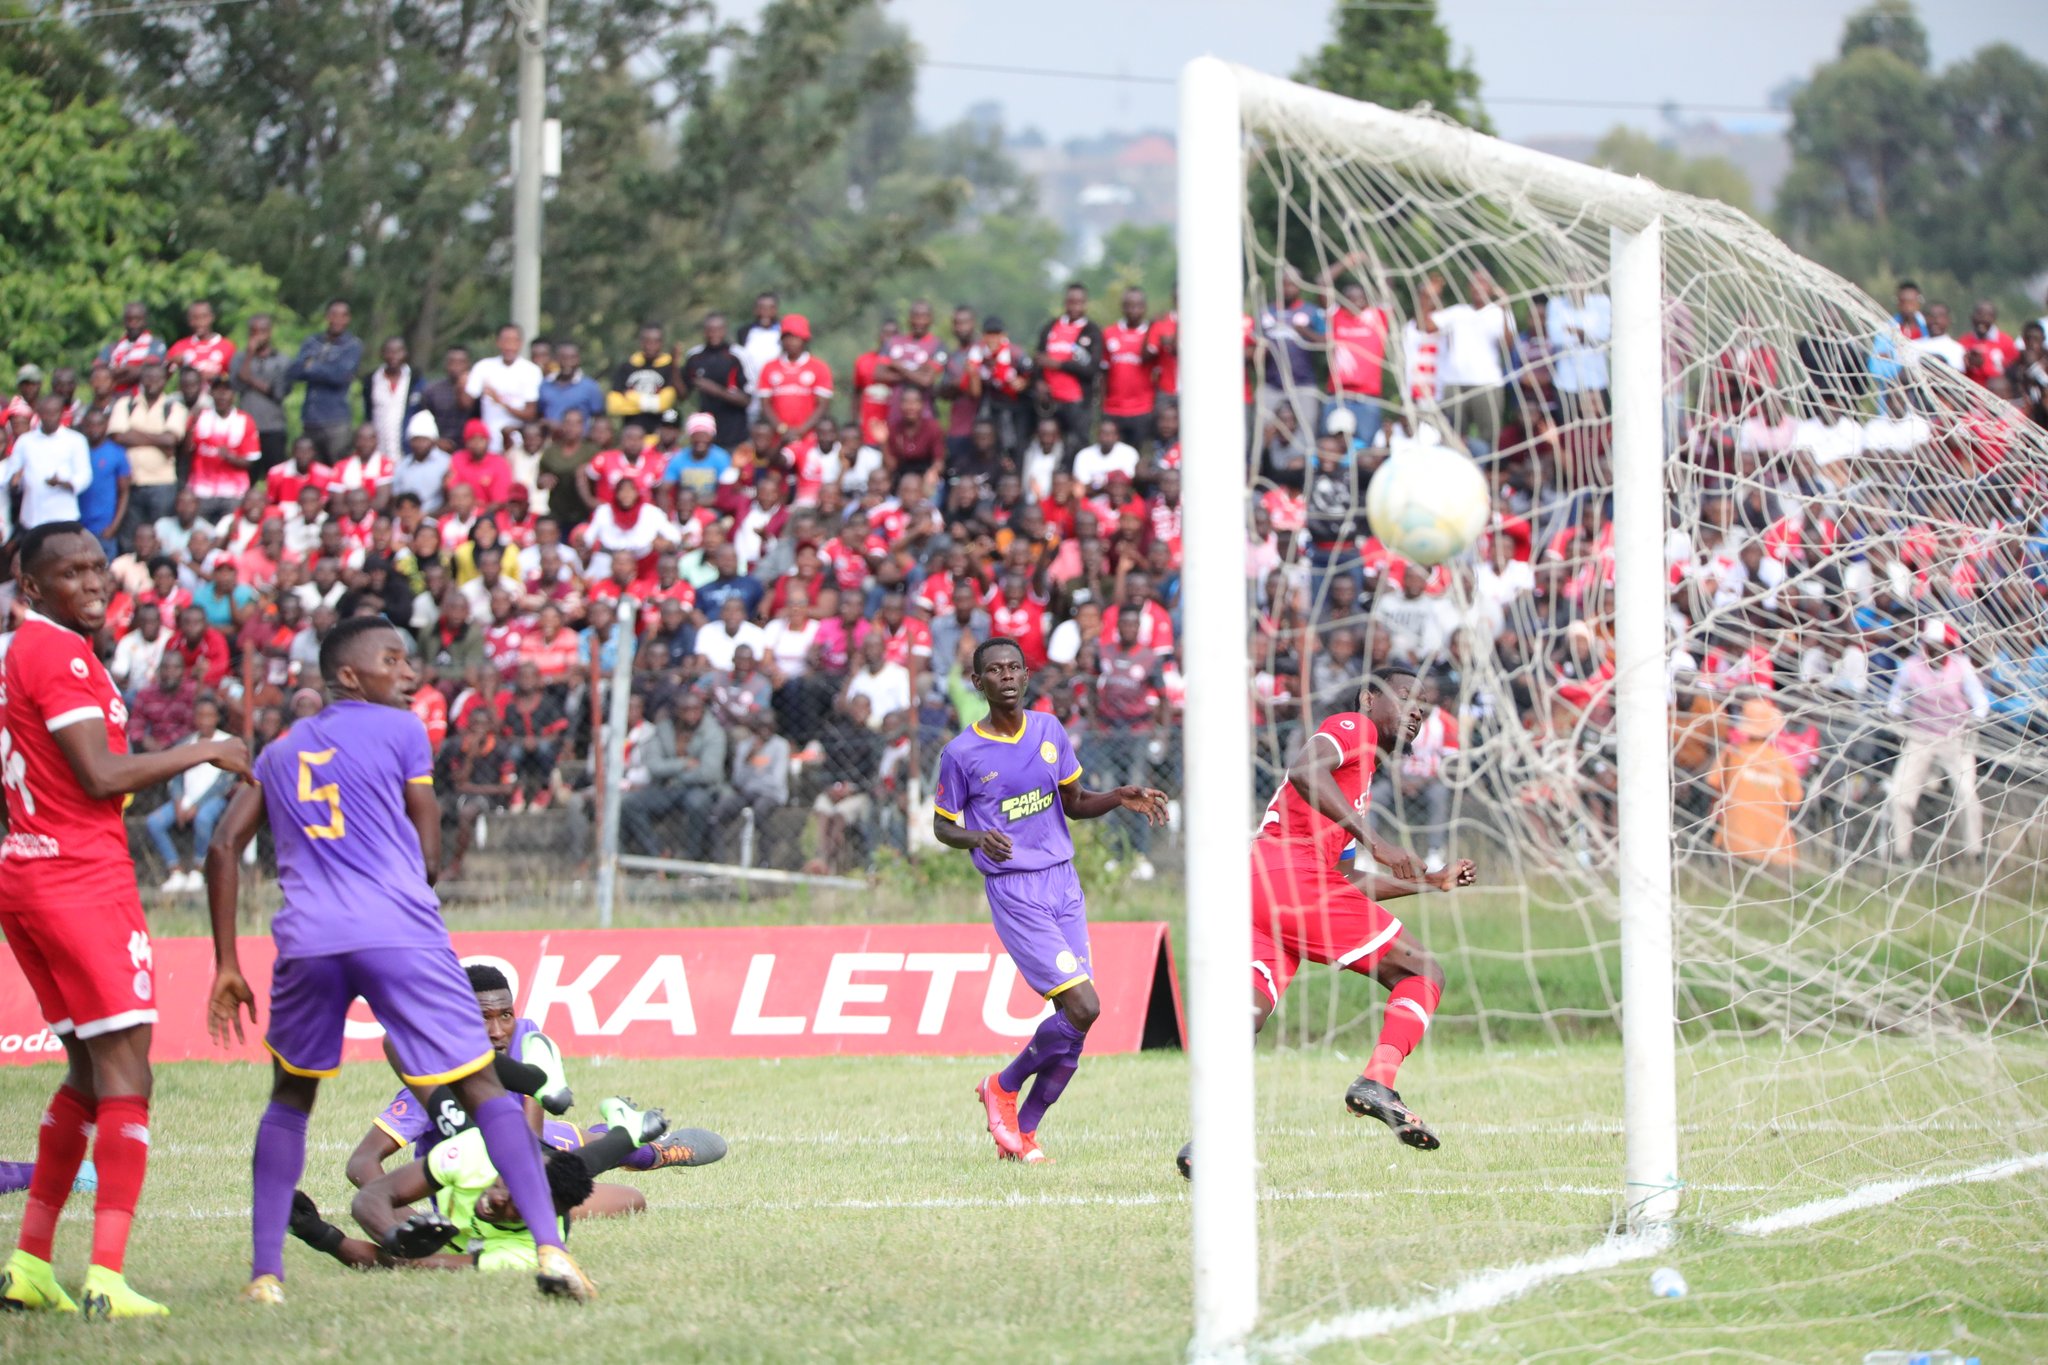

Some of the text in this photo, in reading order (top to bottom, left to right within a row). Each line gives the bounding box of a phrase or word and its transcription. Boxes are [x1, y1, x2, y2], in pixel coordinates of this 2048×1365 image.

[297, 746, 346, 840] 5
[1008, 788, 1041, 810] PARI
[343, 953, 1057, 1039] KA LETU
[0, 1028, 63, 1053] oda
